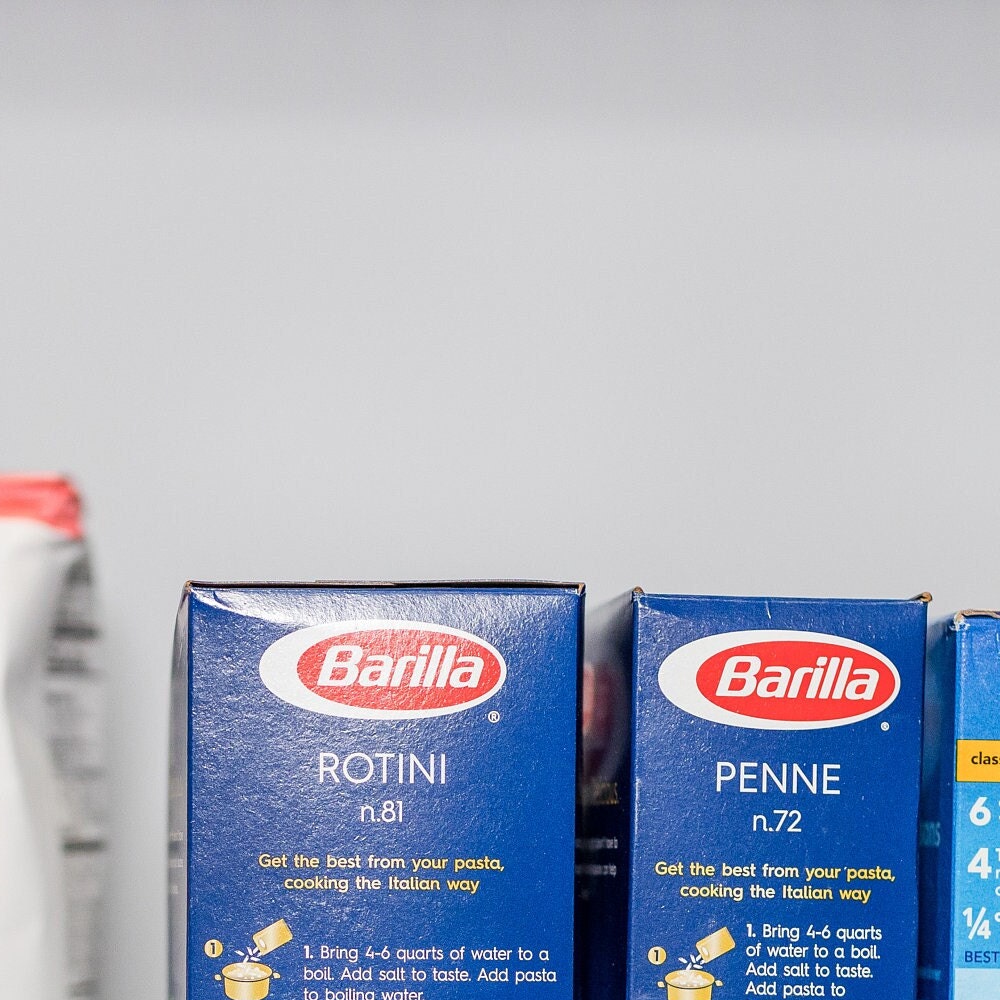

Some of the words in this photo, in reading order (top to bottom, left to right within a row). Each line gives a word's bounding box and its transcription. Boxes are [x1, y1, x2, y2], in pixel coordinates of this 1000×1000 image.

[317, 644, 485, 689] Barilla
[715, 655, 880, 701] Barilla
[319, 753, 447, 785] ROTINI
[716, 761, 841, 795] PENNE
[359, 799, 403, 823] n.81
[752, 809, 802, 833] n.72
[969, 796, 992, 827] 6
[258, 853, 288, 868] Get
[293, 853, 320, 869] the
[326, 854, 362, 870] best
[367, 854, 406, 869] from
[411, 858, 449, 872] your
[454, 855, 505, 872] pasta,
[654, 860, 684, 876] Get
[689, 861, 716, 877] the
[721, 862, 757, 878] best
[761, 863, 800, 878] from
[805, 867, 842, 882] your
[846, 865, 896, 882] pasta,
[967, 847, 993, 880] 4
[284, 874, 349, 893] cooking
[354, 875, 382, 890] the
[388, 875, 441, 891] Italian
[446, 879, 480, 894] way
[679, 883, 744, 902] cooking
[749, 884, 776, 899] the
[782, 884, 833, 900] Italian
[839, 889, 872, 904] way
[746, 923, 757, 938] 1.
[762, 923, 800, 941] Bring
[806, 924, 831, 940] 4-6
[836, 925, 883, 942] quarts
[303, 944, 314, 960] 1.
[319, 944, 359, 962] Bring
[364, 945, 391, 960] 4-6
[396, 945, 444, 963] quarts
[449, 945, 466, 961] of
[470, 946, 513, 961] water
[517, 946, 533, 961] to
[538, 949, 550, 961] a
[745, 942, 762, 957] of
[766, 943, 809, 958] water
[813, 943, 829, 959] to
[834, 947, 845, 959] a
[850, 944, 881, 960] boil.
[964, 951, 1000, 963] BEST
[303, 966, 335, 981] boil.
[340, 966, 373, 981] Add
[378, 966, 406, 982] salt
[411, 966, 427, 982] to
[432, 967, 471, 982] taste.
[477, 967, 509, 982] Add
[515, 968, 557, 985] pasta
[745, 961, 778, 977] Add
[783, 962, 810, 978] salt
[814, 962, 831, 978] to
[835, 963, 874, 979] taste.
[745, 980, 778, 996] Add
[782, 981, 825, 998] pasta
[830, 982, 846, 997] to
